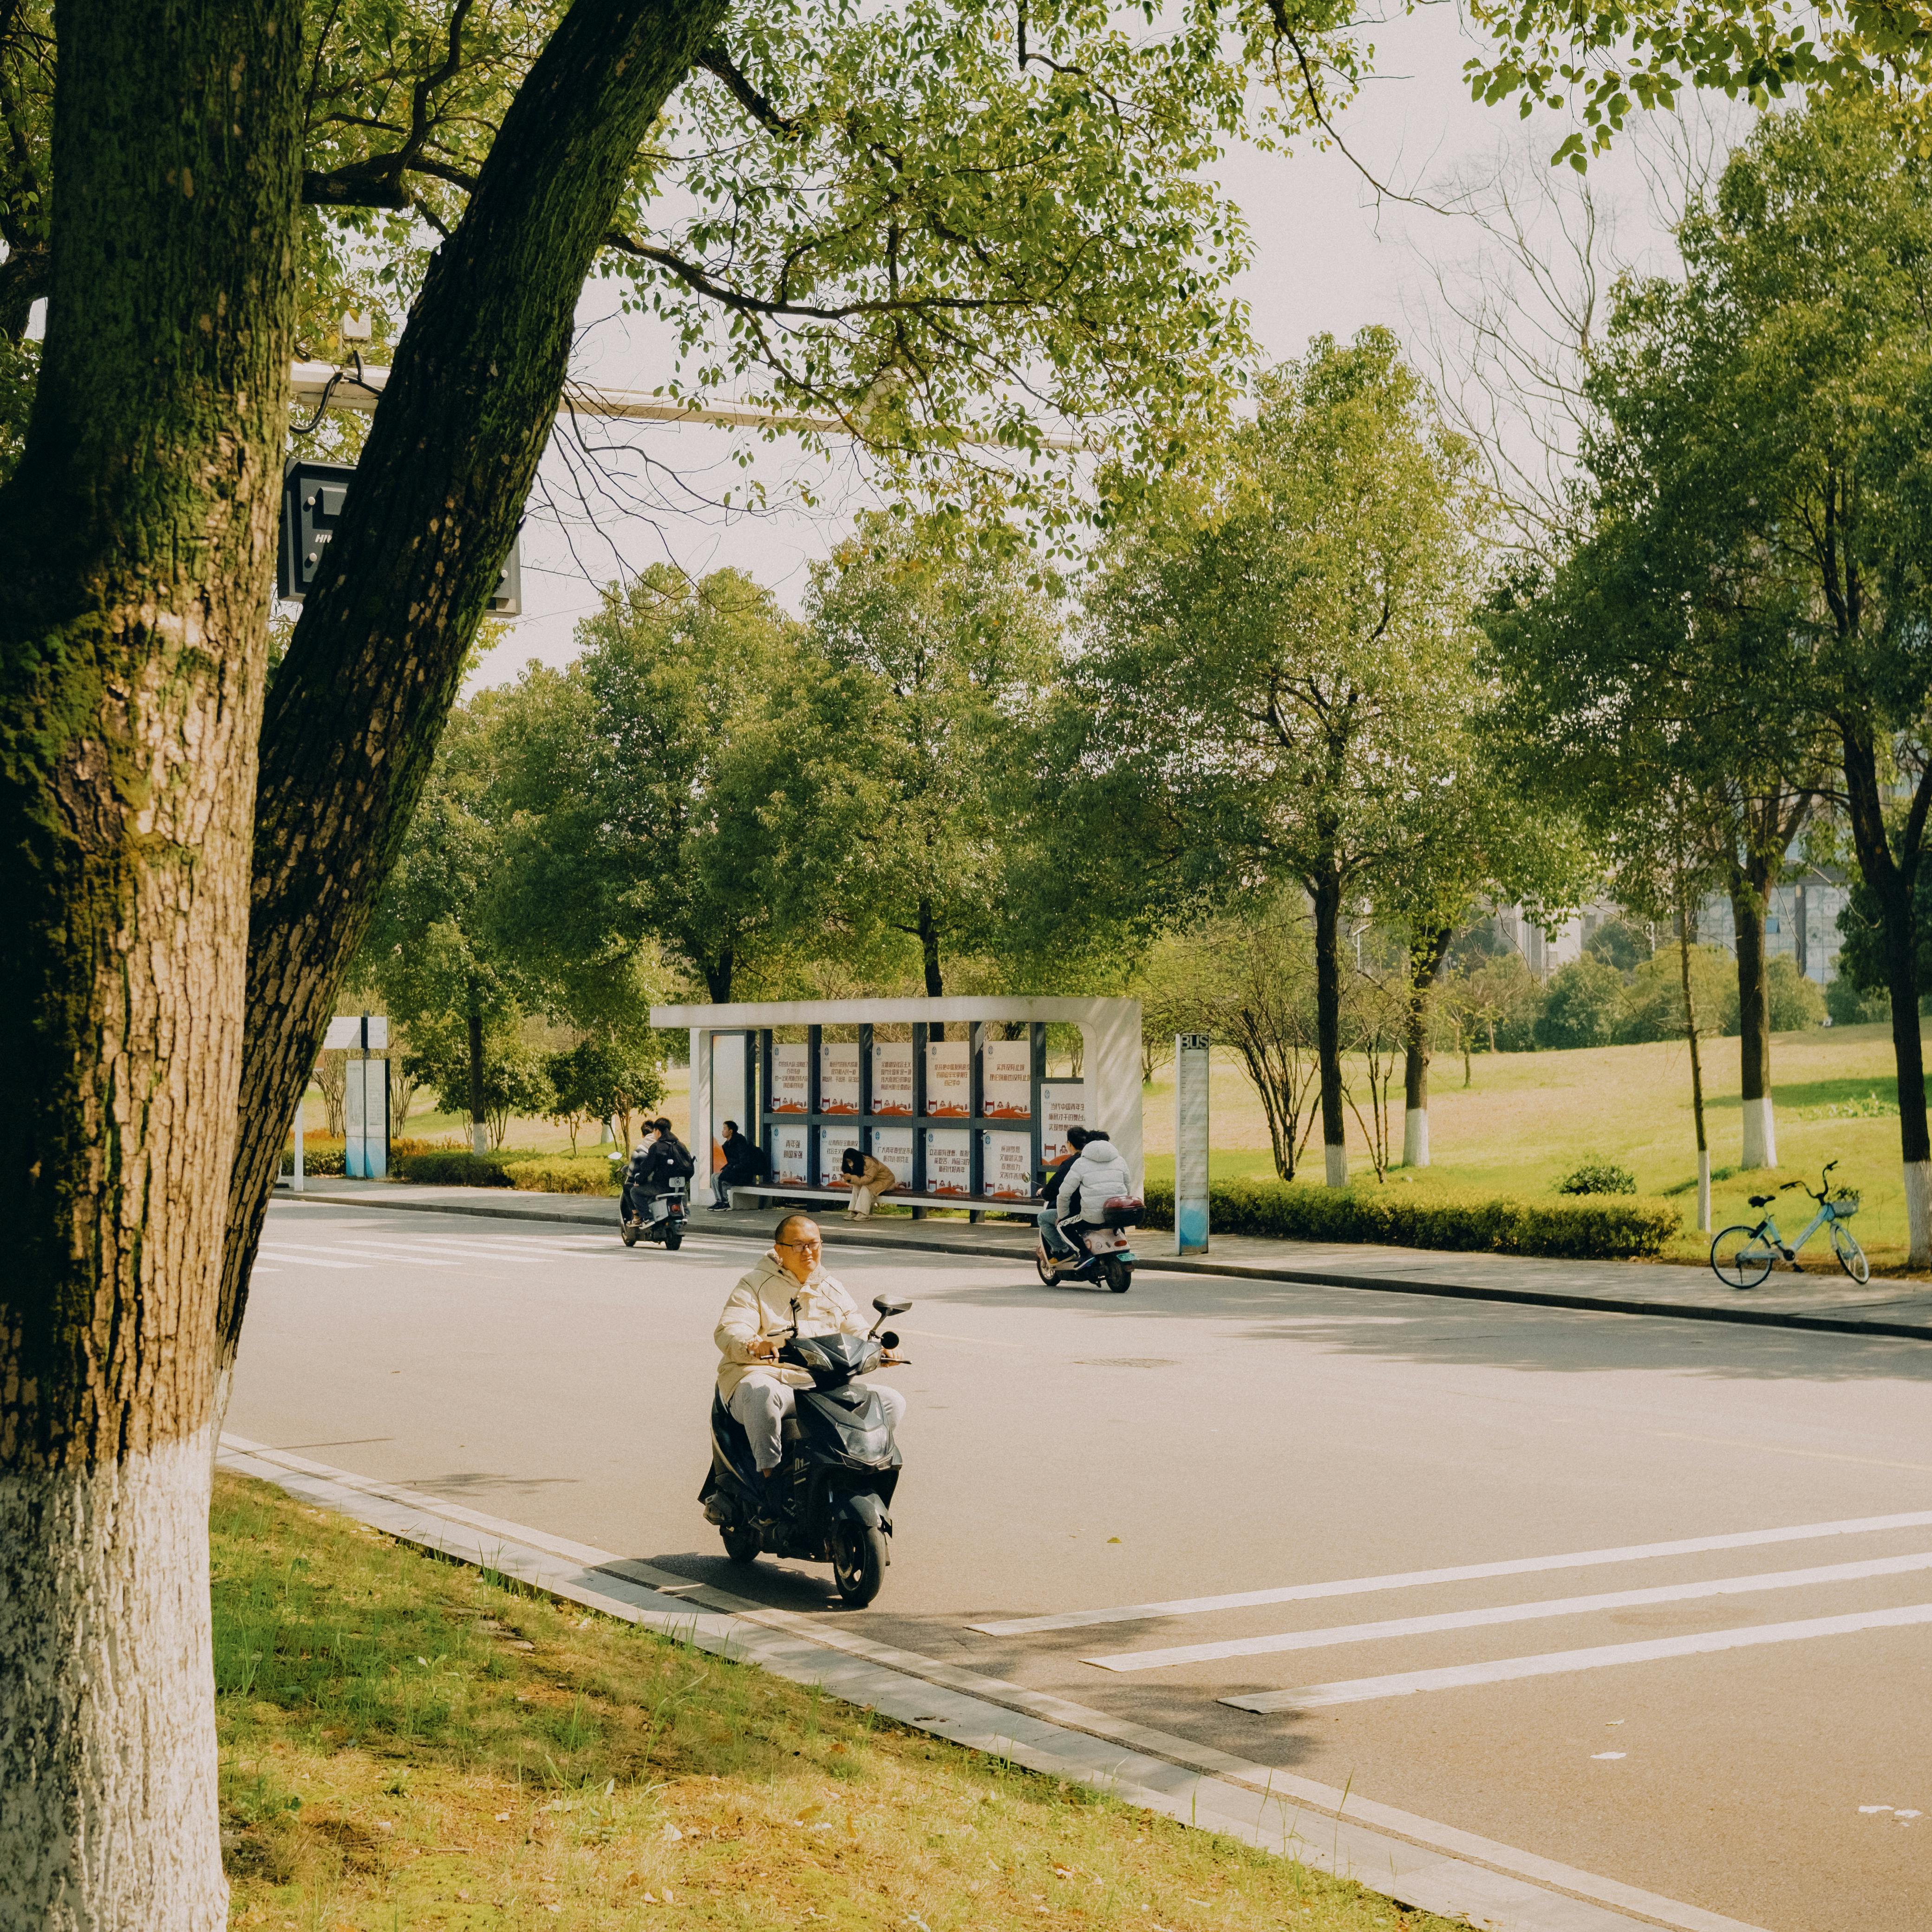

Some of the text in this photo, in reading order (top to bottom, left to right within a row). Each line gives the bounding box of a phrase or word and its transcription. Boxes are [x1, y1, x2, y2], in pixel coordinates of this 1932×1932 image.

[1180, 1035, 1208, 1049] BUS
[786, 1140, 801, 1148] 青年强
[783, 1150, 803, 1159] 则国家强
